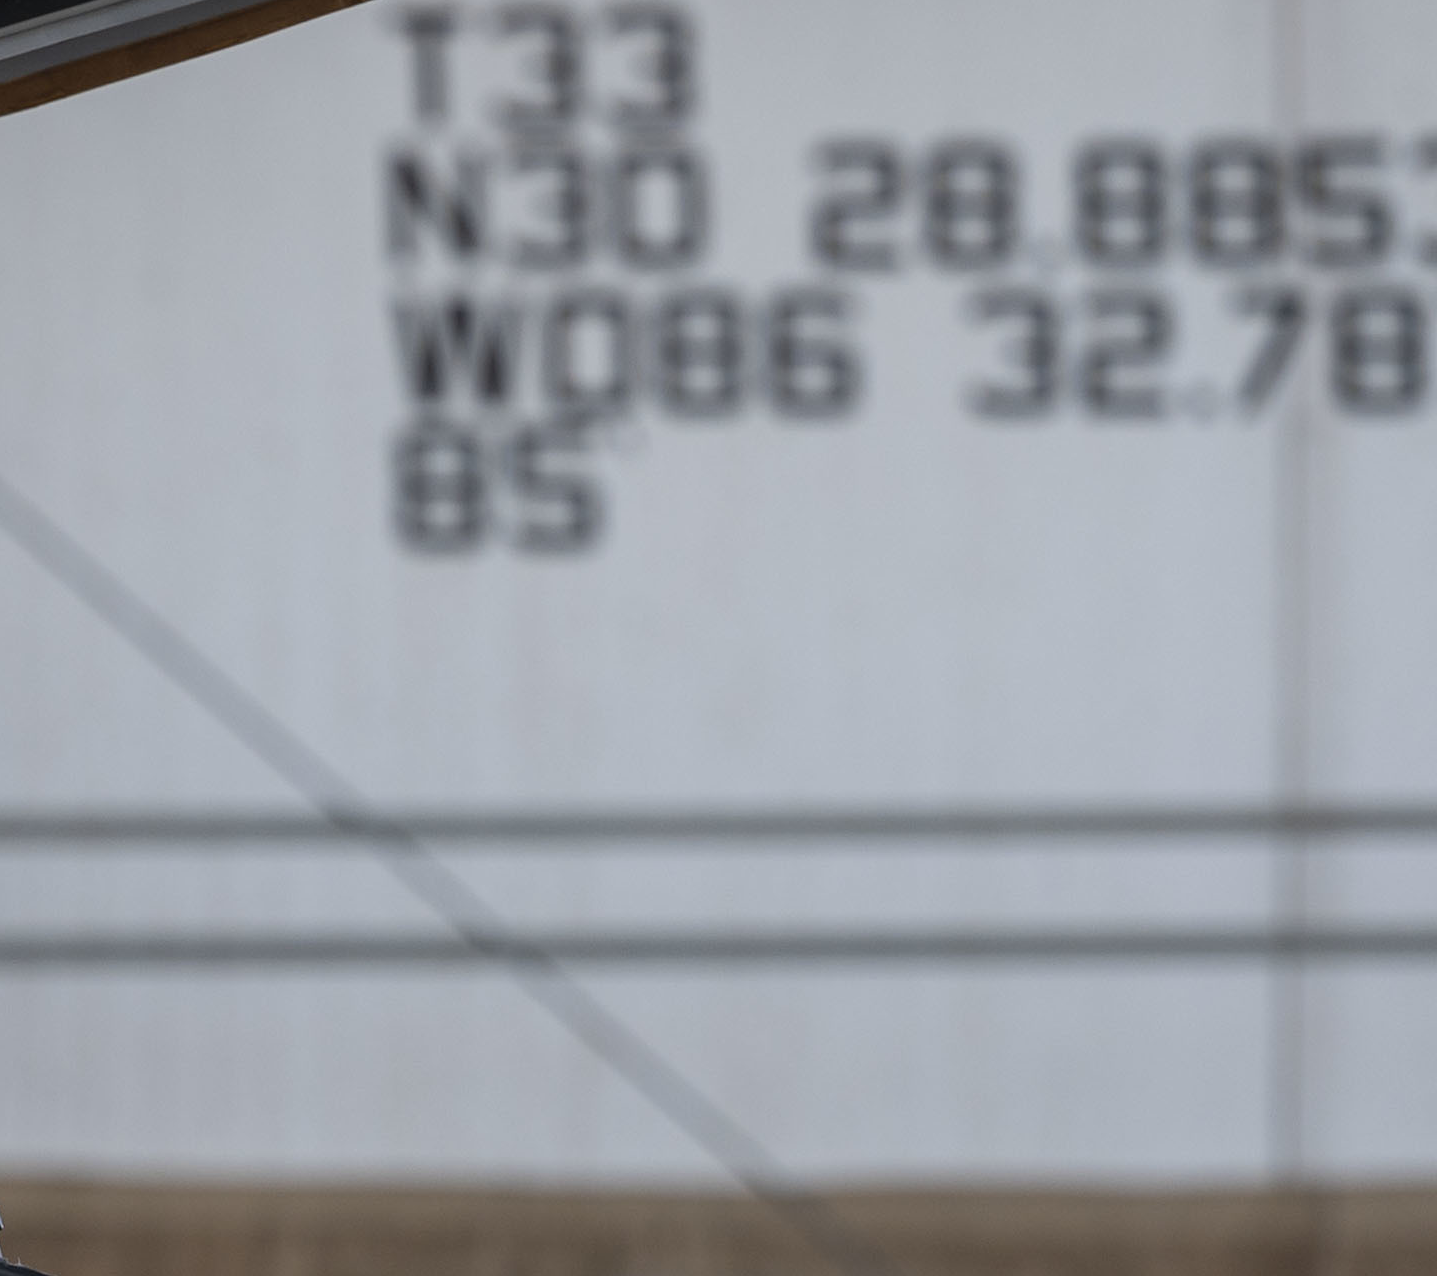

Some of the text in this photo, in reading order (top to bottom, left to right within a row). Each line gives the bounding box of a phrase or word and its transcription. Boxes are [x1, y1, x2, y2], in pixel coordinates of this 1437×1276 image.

[388, 2, 702, 129] T33
[388, 140, 708, 273] N30
[390, 285, 864, 419] W086
